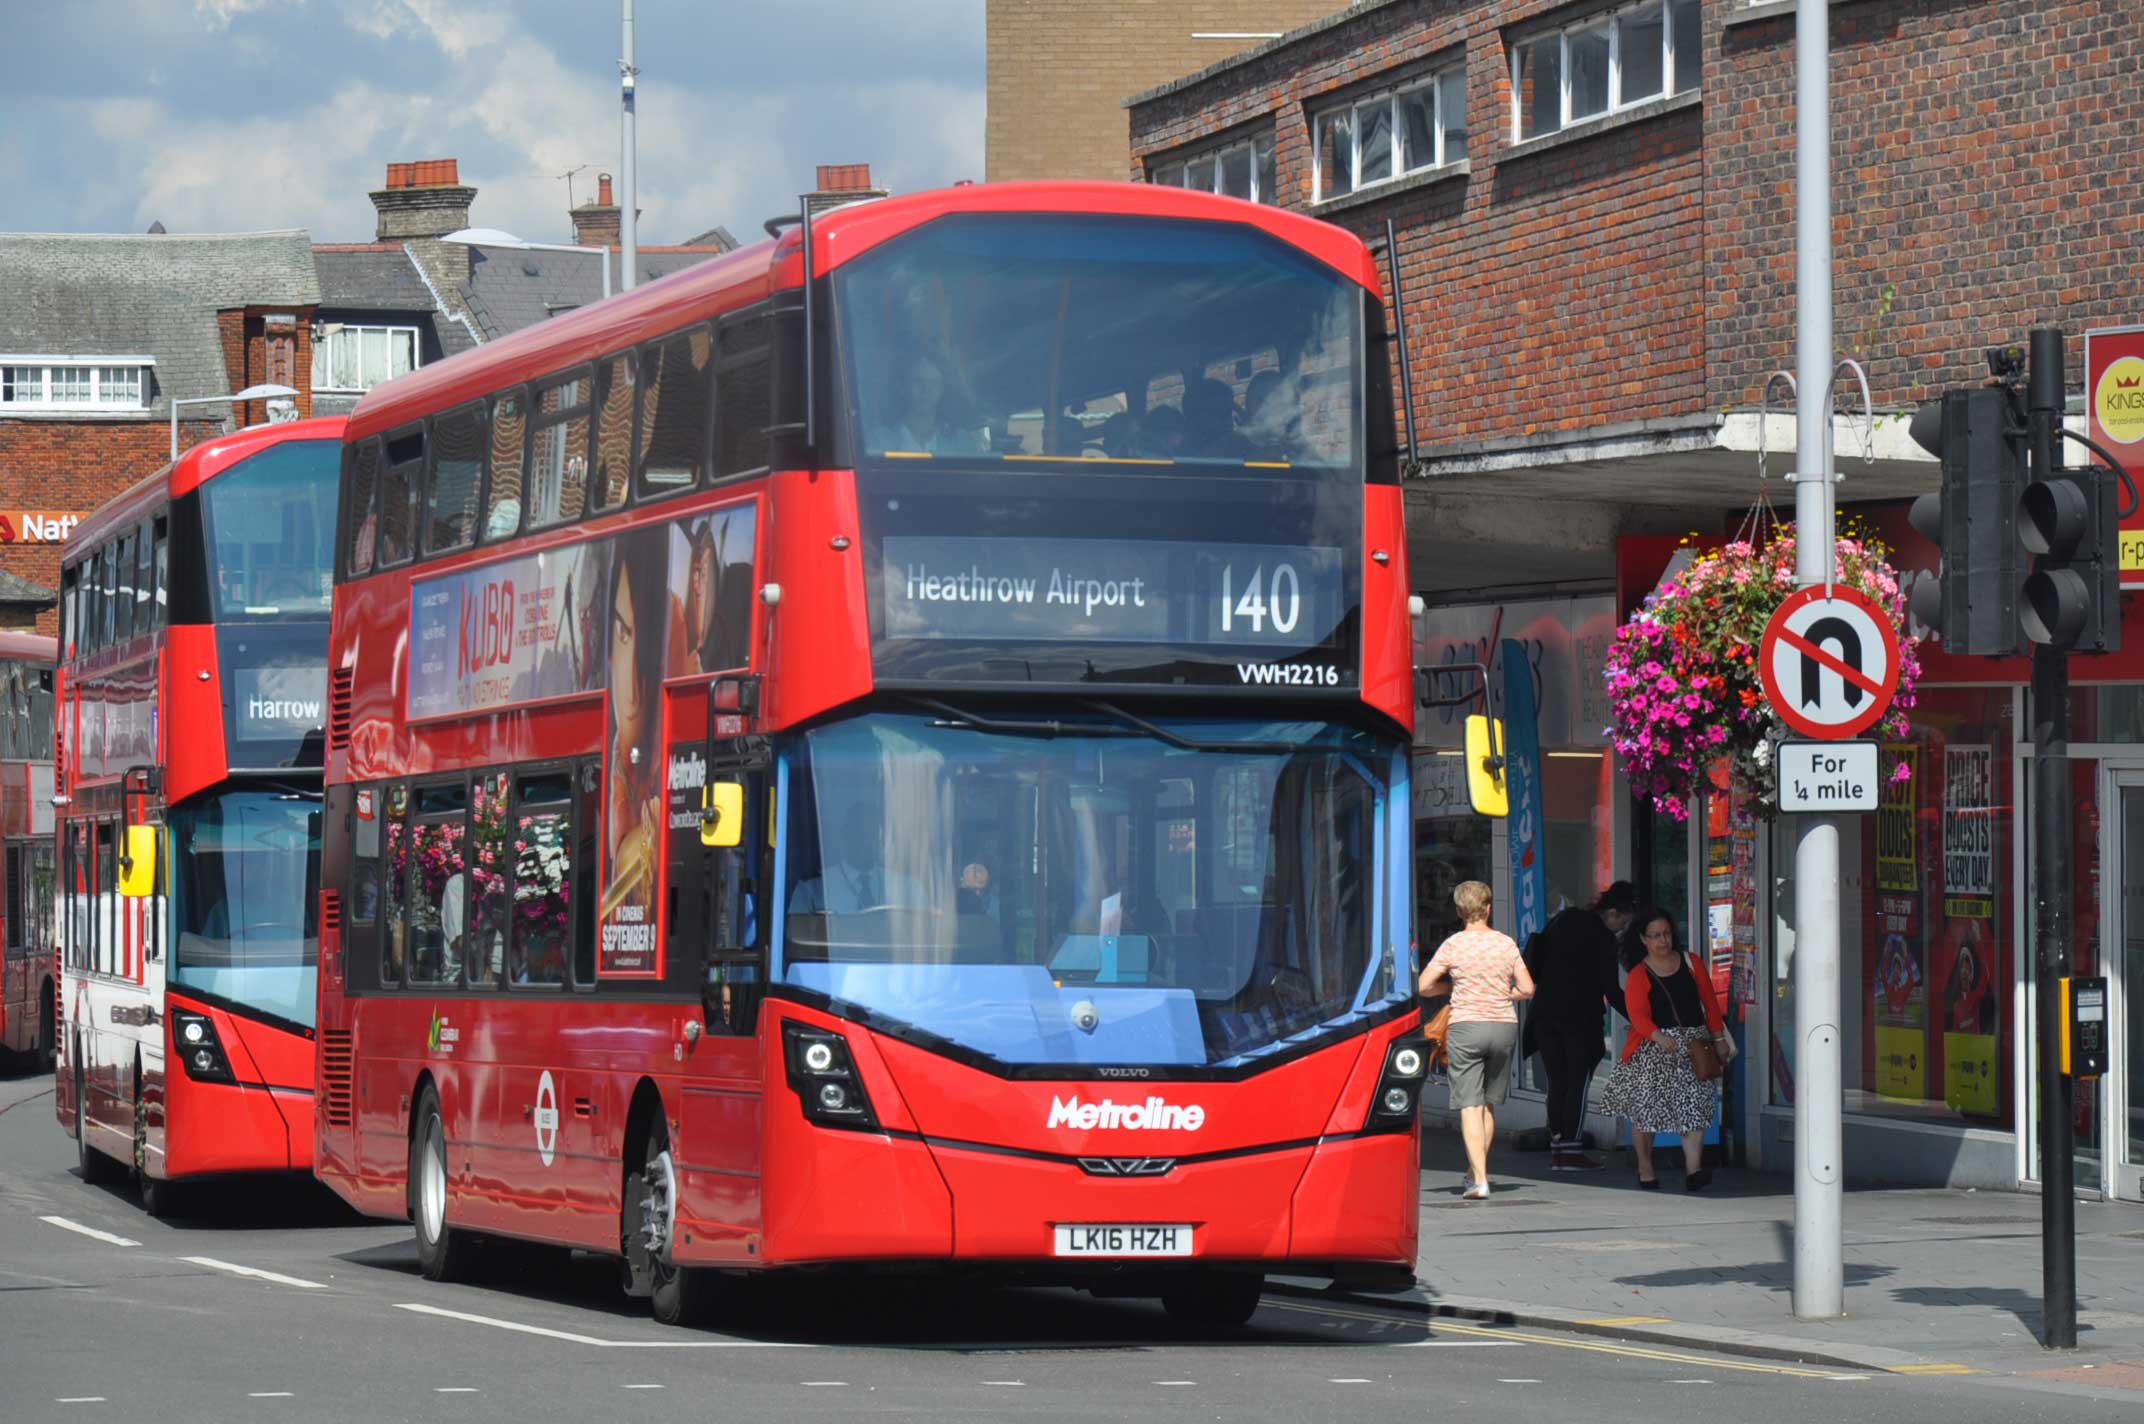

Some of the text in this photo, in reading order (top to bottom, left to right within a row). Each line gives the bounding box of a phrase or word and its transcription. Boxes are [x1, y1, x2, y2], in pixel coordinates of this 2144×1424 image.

[22, 513, 79, 541] Nat
[906, 563, 1300, 633] Heathrow Airport 140
[457, 578, 515, 681] KUBO
[1237, 662, 1339, 686] VWH2216
[249, 693, 320, 719] Harrow
[667, 751, 707, 791] Metroline
[1811, 754, 1847, 773] For
[1817, 779, 1864, 799] mile
[1945, 751, 1989, 807] PRICE
[1945, 810, 1989, 853] BOOSTS
[1945, 856, 1970, 887] EVERY
[602, 923, 656, 951] SEPTEMBER 9
[1098, 1067, 1149, 1078] VOLVO
[1047, 1095, 1205, 1131] Metroline
[1070, 1228, 1176, 1251] LK16 HZH
